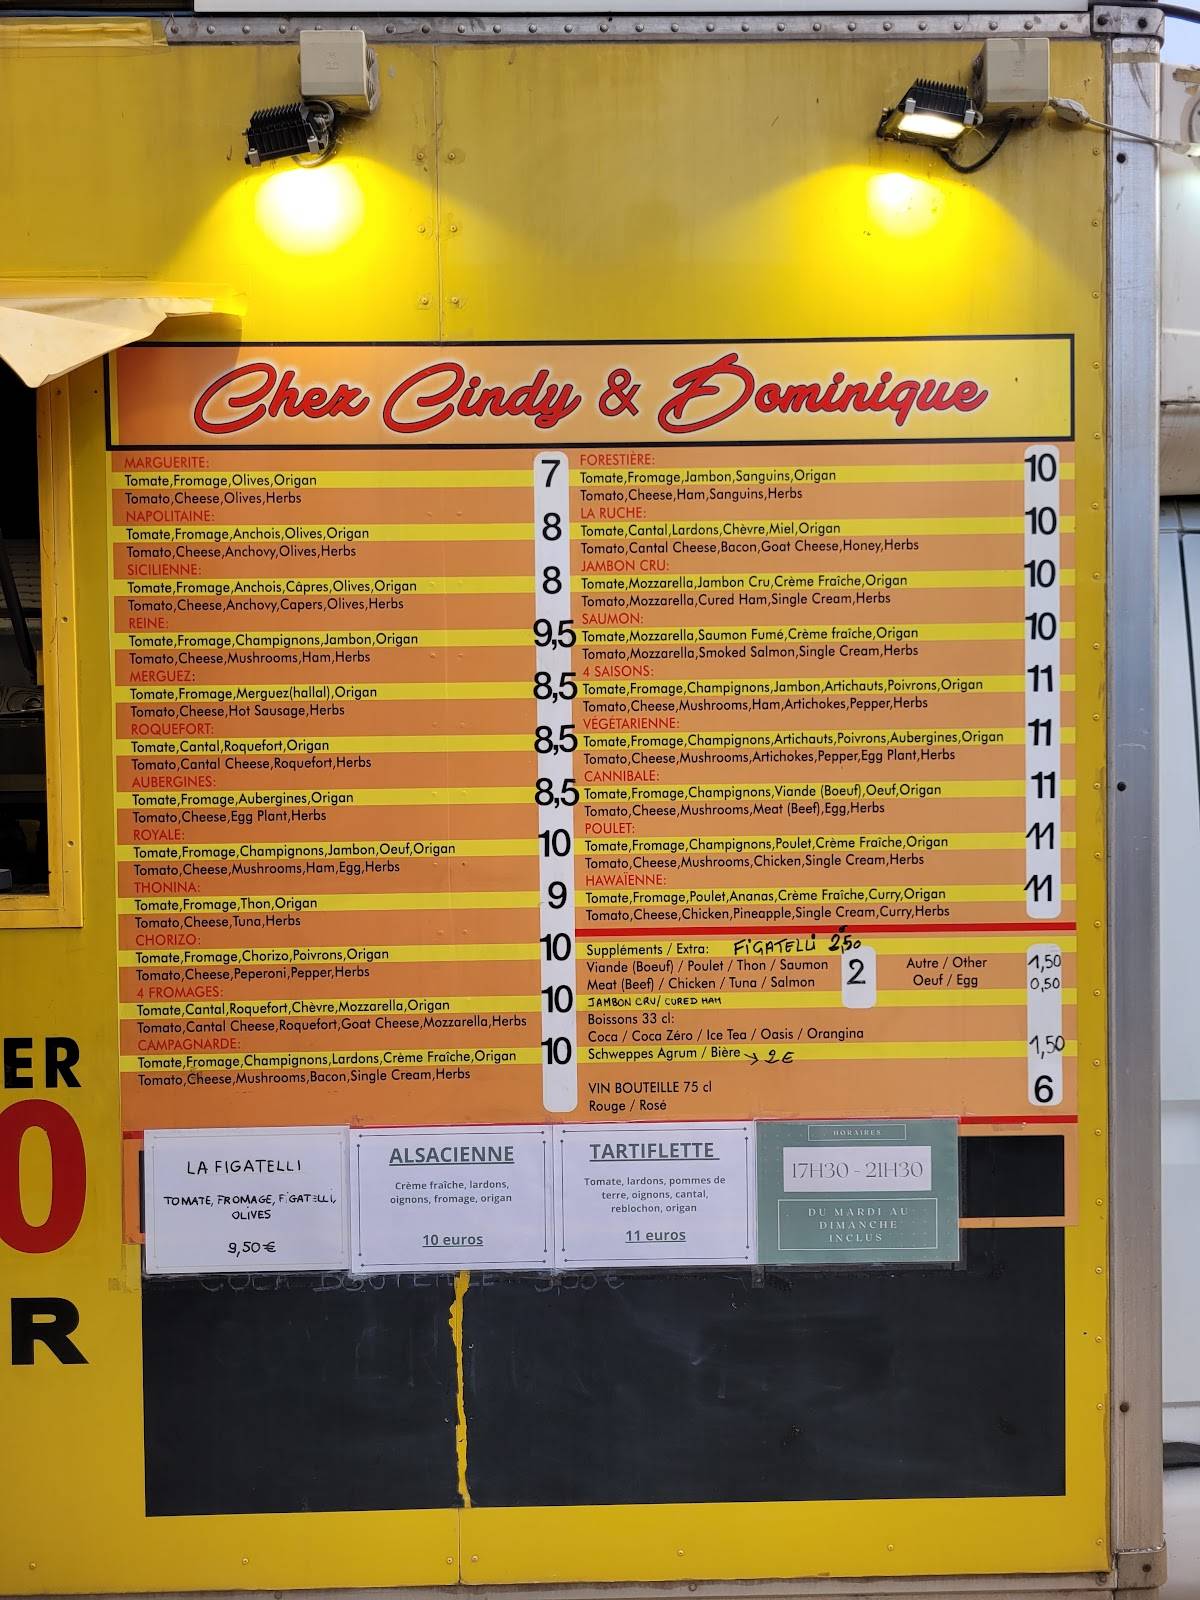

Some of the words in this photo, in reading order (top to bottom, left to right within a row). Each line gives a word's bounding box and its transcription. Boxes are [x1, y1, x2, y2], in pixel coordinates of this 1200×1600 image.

[194, 362, 369, 434] Chez
[382, 362, 582, 434] Cindy
[598, 368, 641, 417] &
[658, 352, 988, 434] Dominique
[124, 456, 210, 469] MARGUERITE:
[580, 450, 656, 466] FORESTIÈRE:
[542, 460, 560, 487] 7
[1025, 454, 1056, 482] 10
[124, 474, 316, 488] Tomate,Fromage,Olives,Origan
[580, 469, 835, 485] Tomate,Fromage,Jambon,Sanguins,Origan
[125, 509, 215, 523] NAPOLITAINE:
[581, 507, 596, 520] LA
[600, 506, 647, 520] RUCHE:
[543, 513, 561, 541] 8
[1025, 507, 1056, 535] 10
[126, 527, 368, 542] Tomate,Fromage,Anchois,Olives,Origan
[581, 522, 840, 538] Tomate,Cantal,Lardons,Chèvre,Miel,Origan
[127, 563, 202, 577] SICILIENNE:
[581, 560, 635, 573] JAMBON
[640, 559, 670, 572] CRU:
[1024, 560, 1055, 587] 10
[543, 566, 561, 594] 8
[127, 580, 416, 596] Tomate,Fromage,Anchois,Câpres,Olives,Origan
[129, 616, 169, 630] REINE:
[582, 612, 644, 625] SAUMON:
[1025, 612, 1056, 640] 10
[129, 633, 418, 649] Tomate,Fromage,Champignons,Jambon,Origan
[533, 619, 576, 650] 9,5
[130, 669, 196, 683] MERGUEZ:
[582, 666, 589, 678] 4
[595, 665, 654, 678] SAISONS:
[1028, 665, 1053, 692] 11
[130, 686, 377, 702] Tomate,Fromage,Merguez(hallal),Origan
[534, 672, 577, 703] 8,5
[583, 678, 982, 696] Tomate,Fromage,Champignons,Jambon,Artichauts,Poivrons,Origan
[131, 722, 214, 736] ROQUEFORT:
[583, 714, 680, 730] VÉGÉTARIENNE:
[534, 724, 577, 755] 8,5
[1028, 719, 1051, 746] 11
[131, 739, 329, 754] Tomate,Cantal,Roquefort,Origan
[132, 775, 217, 789] AUBERGINES:
[584, 769, 660, 783] CANNIBALE:
[1031, 772, 1055, 798] 11
[132, 792, 353, 807] Tomate,Fromage,Aubergines,Origan
[535, 778, 579, 808] 8,5
[133, 828, 186, 842] ROYALE:
[585, 821, 635, 835] POULET:
[1026, 822, 1054, 849] 11
[538, 829, 570, 857] 10
[585, 837, 855, 853] Tomate,Fromage,Champignons,Poulet,Crème
[860, 836, 948, 850] Fraîche,Origan
[585, 870, 667, 887] HAWAÏENNE:
[134, 881, 201, 894] THONINA:
[548, 881, 567, 909] 9
[1024, 875, 1052, 901] 11
[134, 897, 317, 912] Tomate,Fromage,Thon,Origan
[136, 933, 201, 947] CHORIZO:
[540, 933, 571, 961] 10
[136, 948, 388, 965] Tomate,Fromage,Chorizo,Poivrons,Origan
[587, 944, 663, 958] Suppléments
[677, 943, 708, 954] Extra:
[587, 961, 628, 973] Viande
[633, 960, 673, 974] (Boeuf)
[688, 960, 723, 971] Poulet
[737, 960, 766, 970] Thon
[780, 959, 828, 970] Saumon
[907, 958, 938, 968] Autre
[953, 956, 987, 968] Other
[1028, 955, 1061, 972] 1,50
[847, 959, 865, 984] 2
[587, 980, 617, 990] Meat
[622, 977, 654, 992] (Beef)
[668, 977, 715, 989] Chicken
[729, 977, 757, 988] Tuna
[771, 976, 814, 987] Salmon
[913, 974, 943, 986] Oeuf
[957, 974, 978, 988] Egg
[1031, 978, 1059, 992] 0,50
[136, 987, 144, 999] 4
[149, 986, 224, 1000] FROMAGES:
[542, 985, 573, 1013] 10
[588, 1014, 638, 1025] Boissons
[642, 1013, 657, 1024] 33
[662, 1013, 675, 1024] cl:
[588, 1031, 617, 1042] Coca
[632, 1030, 662, 1041] Coca
[666, 1030, 693, 1041] Zéro
[707, 1029, 723, 1040] Ice
[727, 1029, 746, 1040] Tea
[761, 1028, 793, 1039] Oasis
[807, 1027, 863, 1041] Orangina
[137, 1036, 241, 1051] CAMPAGNARDE:
[541, 1037, 571, 1064] 10
[1030, 1036, 1065, 1059] 1,50
[588, 1048, 653, 1062] Schweppes
[657, 1047, 697, 1061] Agrum
[711, 1046, 740, 1057] Bière
[588, 1083, 610, 1094] VIN
[615, 1081, 679, 1093] BOUTEILLE
[684, 1081, 698, 1092] 75
[703, 1081, 711, 1092] cl
[1035, 1075, 1053, 1103] 6
[589, 1100, 625, 1114] Rouge
[640, 1099, 666, 1110] Rosé
[389, 1146, 514, 1164] ALSACIENNE
[589, 1142, 714, 1159] TARTIFLETTE
[792, 1162, 849, 1178] 17H30
[865, 1161, 923, 1178] 21H30
[395, 1182, 427, 1190] Crème
[429, 1180, 467, 1190] fraîche,
[469, 1180, 509, 1190] lardons,
[584, 1178, 624, 1187] Tomate,
[627, 1176, 666, 1186] lardons,
[669, 1177, 711, 1187] pommes
[713, 1175, 726, 1184] de
[390, 1195, 431, 1206] oignons,
[434, 1194, 478, 1205] fromage,
[480, 1193, 512, 1205] origan
[601, 1192, 629, 1200] terre,
[631, 1190, 673, 1201] oignons,
[675, 1189, 708, 1199] cantal,
[611, 1204, 663, 1213] reblochon,
[665, 1203, 697, 1214] origan
[808, 1208, 826, 1216] DU
[834, 1207, 881, 1216] MARDI
[889, 1207, 909, 1216] AU
[819, 1220, 898, 1230] DIMANCHE
[423, 1235, 438, 1247] 10
[443, 1236, 483, 1247] euros
[625, 1230, 641, 1242] 11
[645, 1231, 686, 1242] euros
[829, 1233, 883, 1242] INCLUS
